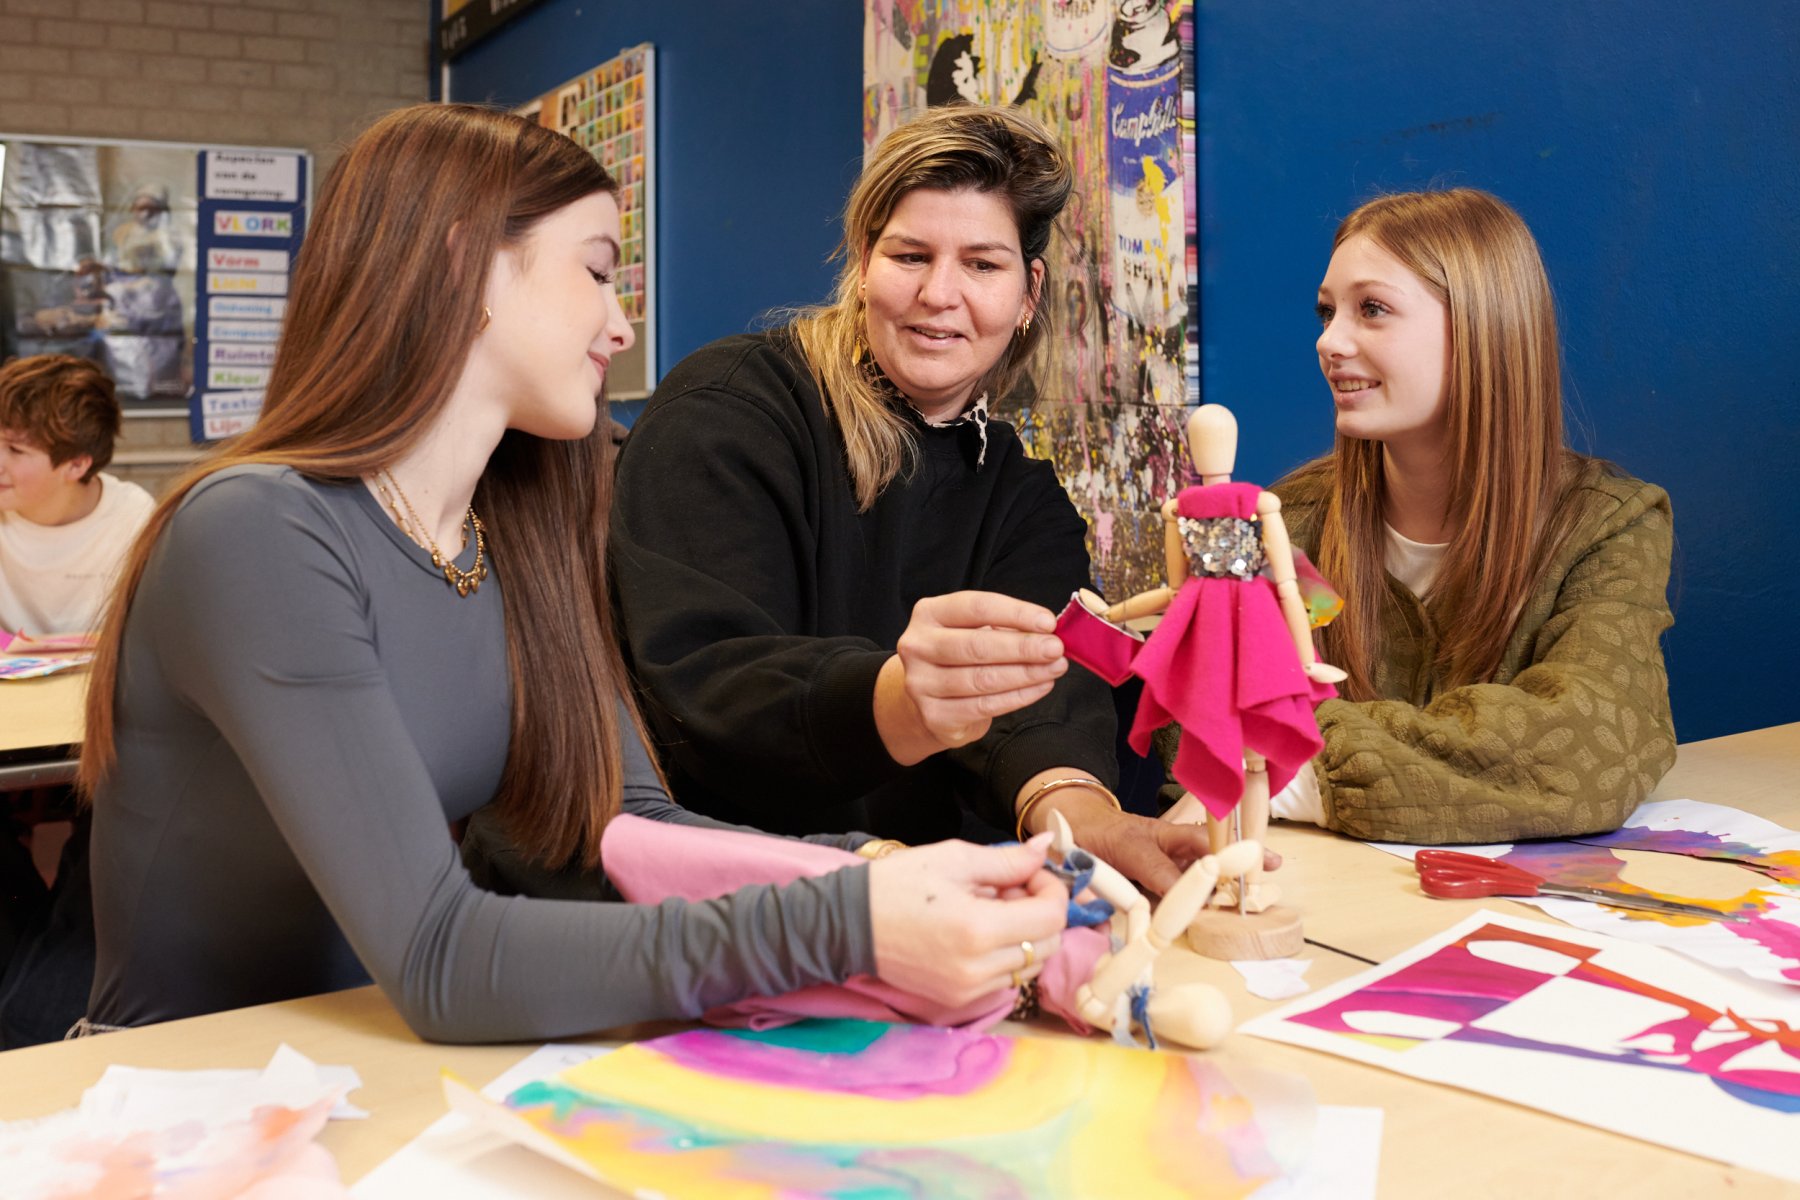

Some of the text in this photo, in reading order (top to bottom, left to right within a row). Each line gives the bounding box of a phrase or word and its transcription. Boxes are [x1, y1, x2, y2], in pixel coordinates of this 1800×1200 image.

[216, 214, 291, 232] VLORK
[213, 253, 260, 268] Vorm
[212, 275, 257, 291] Licht
[213, 371, 260, 385] Kleur
